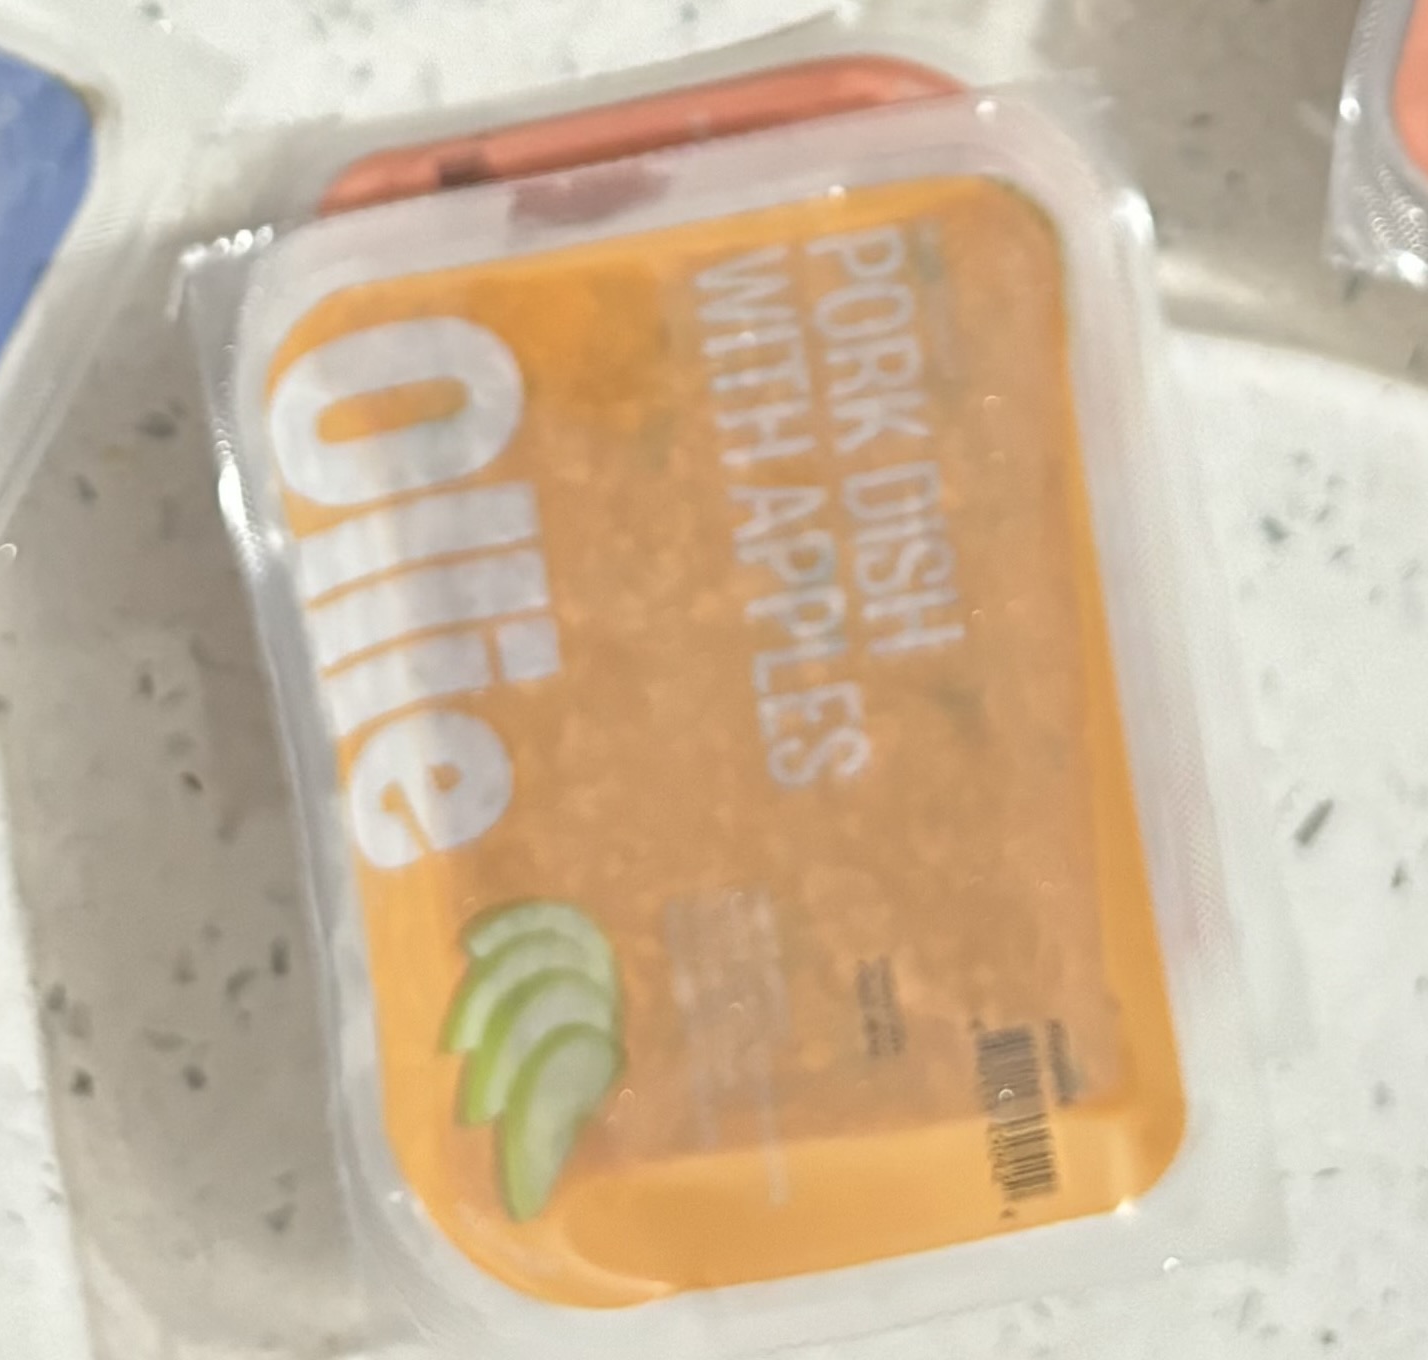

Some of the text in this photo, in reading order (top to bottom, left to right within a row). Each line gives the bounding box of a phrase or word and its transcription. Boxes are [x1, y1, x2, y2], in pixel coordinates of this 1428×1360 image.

[694, 242, 817, 470] WITH
[802, 223, 967, 658] PORK DISH
[266, 313, 562, 871] Ollie
[725, 483, 872, 792] APPLES
